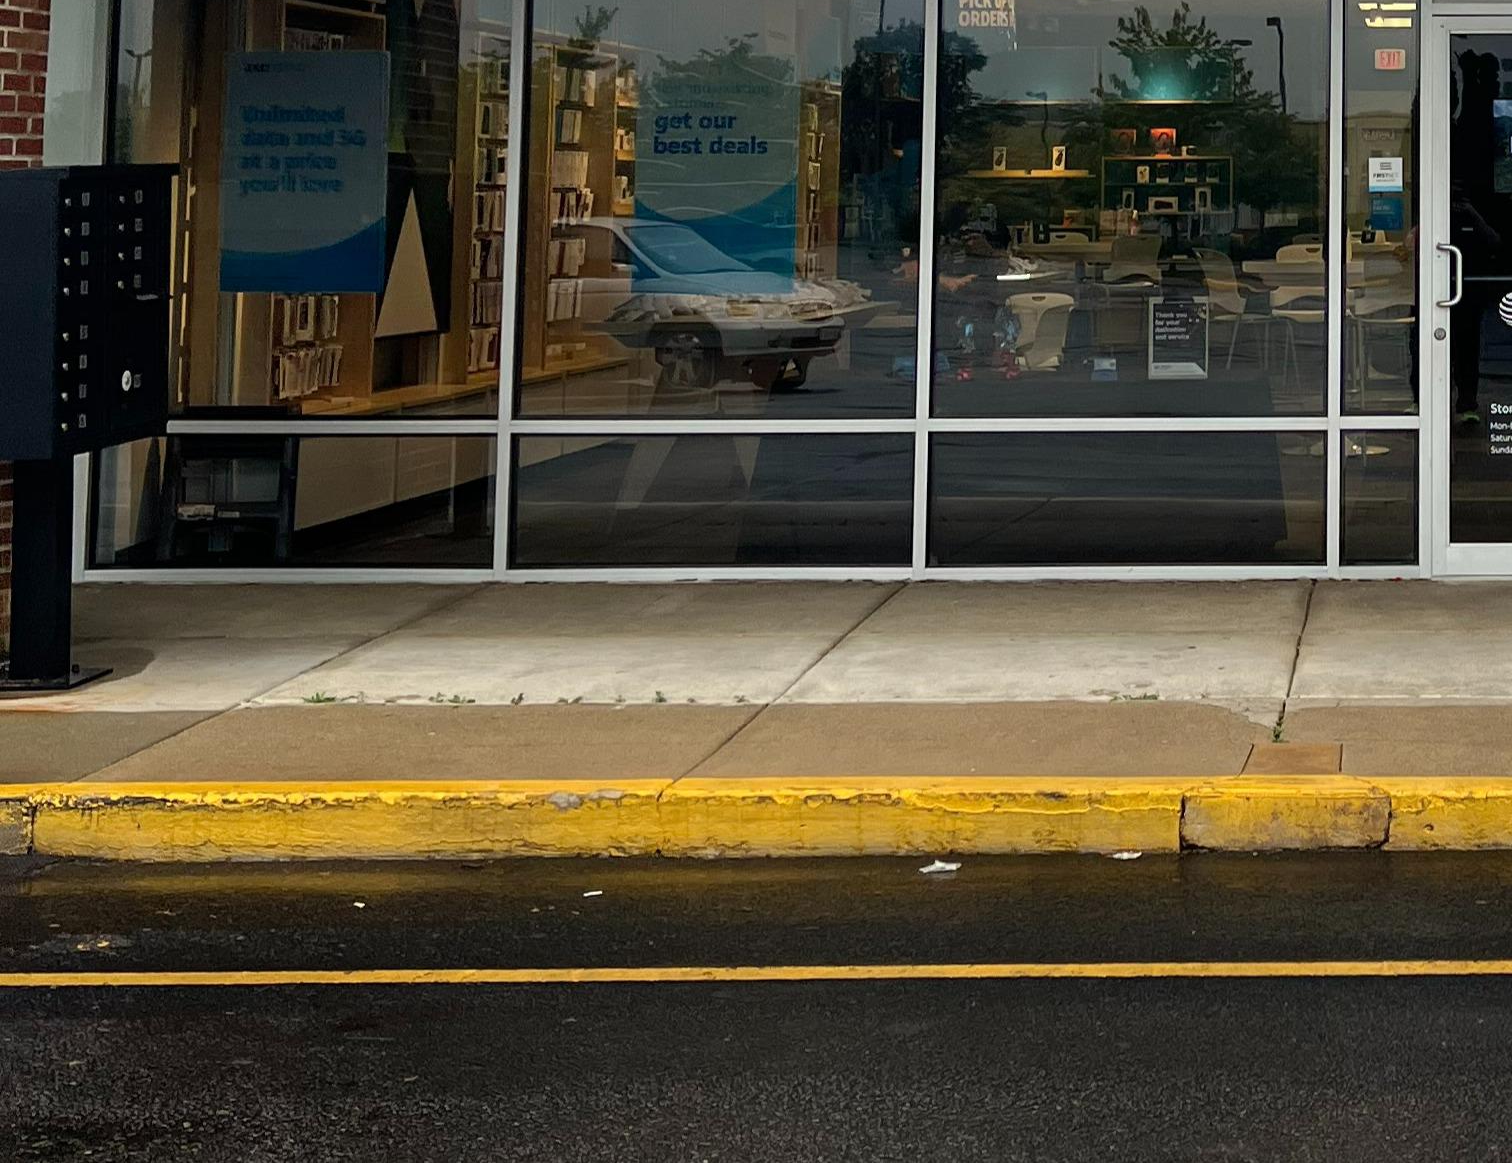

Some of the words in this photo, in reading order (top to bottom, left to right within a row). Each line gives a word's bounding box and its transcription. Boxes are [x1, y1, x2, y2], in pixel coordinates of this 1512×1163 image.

[654, 112, 692, 134] get
[700, 115, 737, 129] our
[654, 136, 702, 154] best
[709, 136, 768, 154] deals
